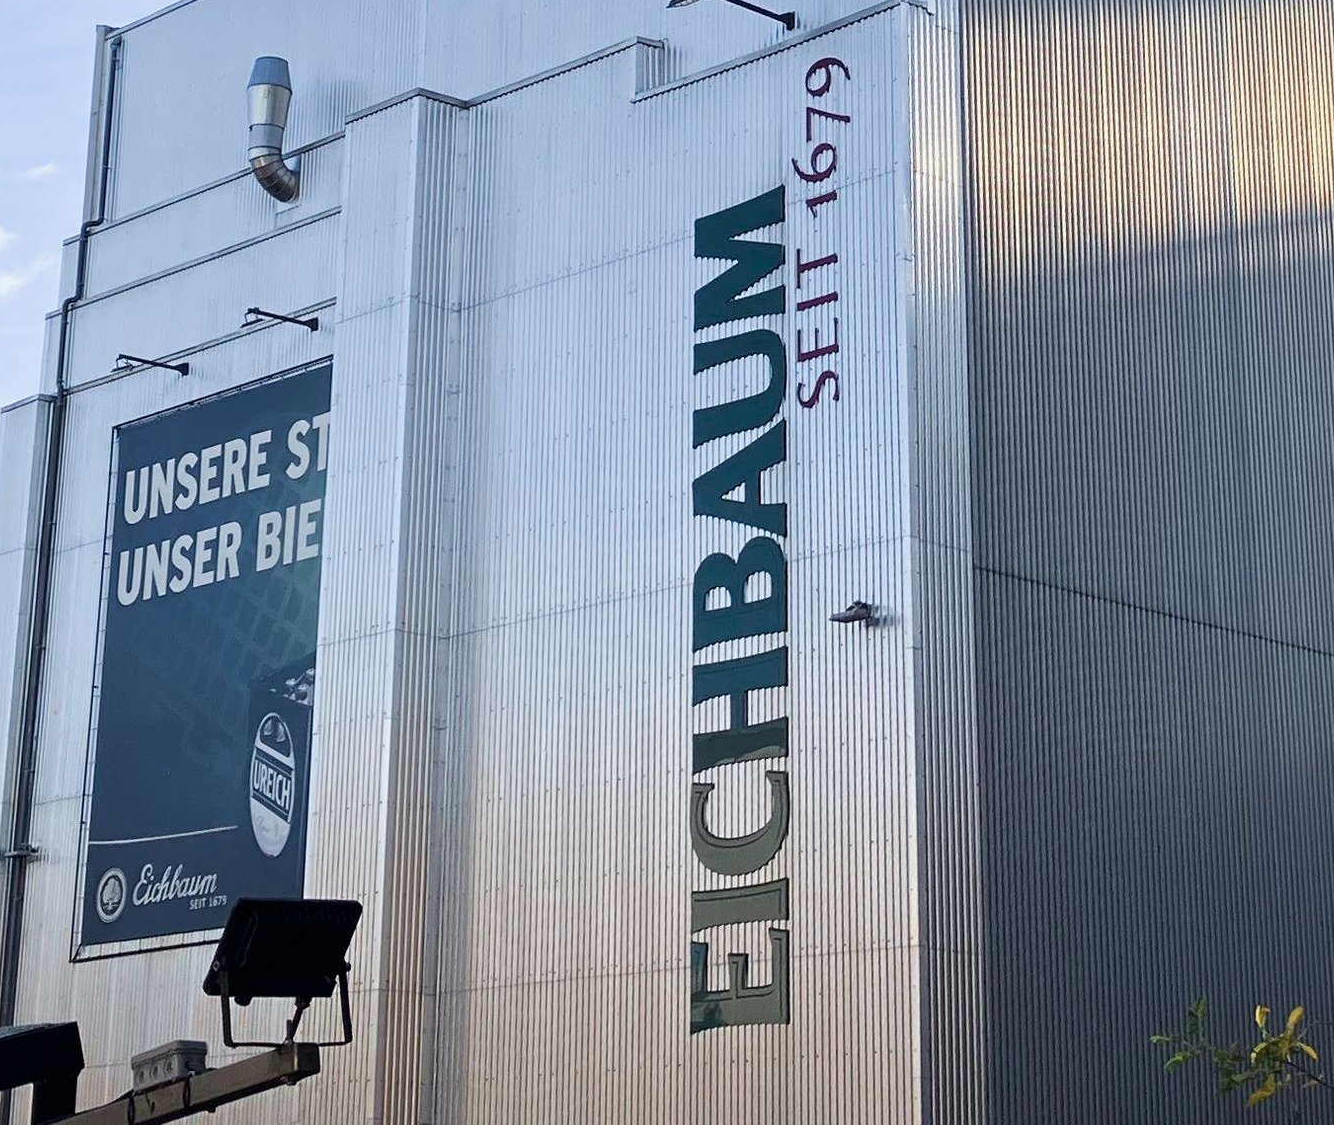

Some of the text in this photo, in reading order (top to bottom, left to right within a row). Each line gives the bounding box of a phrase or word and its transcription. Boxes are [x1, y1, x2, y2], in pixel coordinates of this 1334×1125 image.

[791, 57, 852, 410] SEIT 1679
[123, 429, 273, 525] UNSERE
[117, 498, 322, 607] UNSER BIE
[690, 183, 791, 1036] EICHBAUM
[253, 759, 292, 811] UREICH
[132, 863, 218, 906] Eichbaum
[189, 894, 228, 911] SEIT 1679
